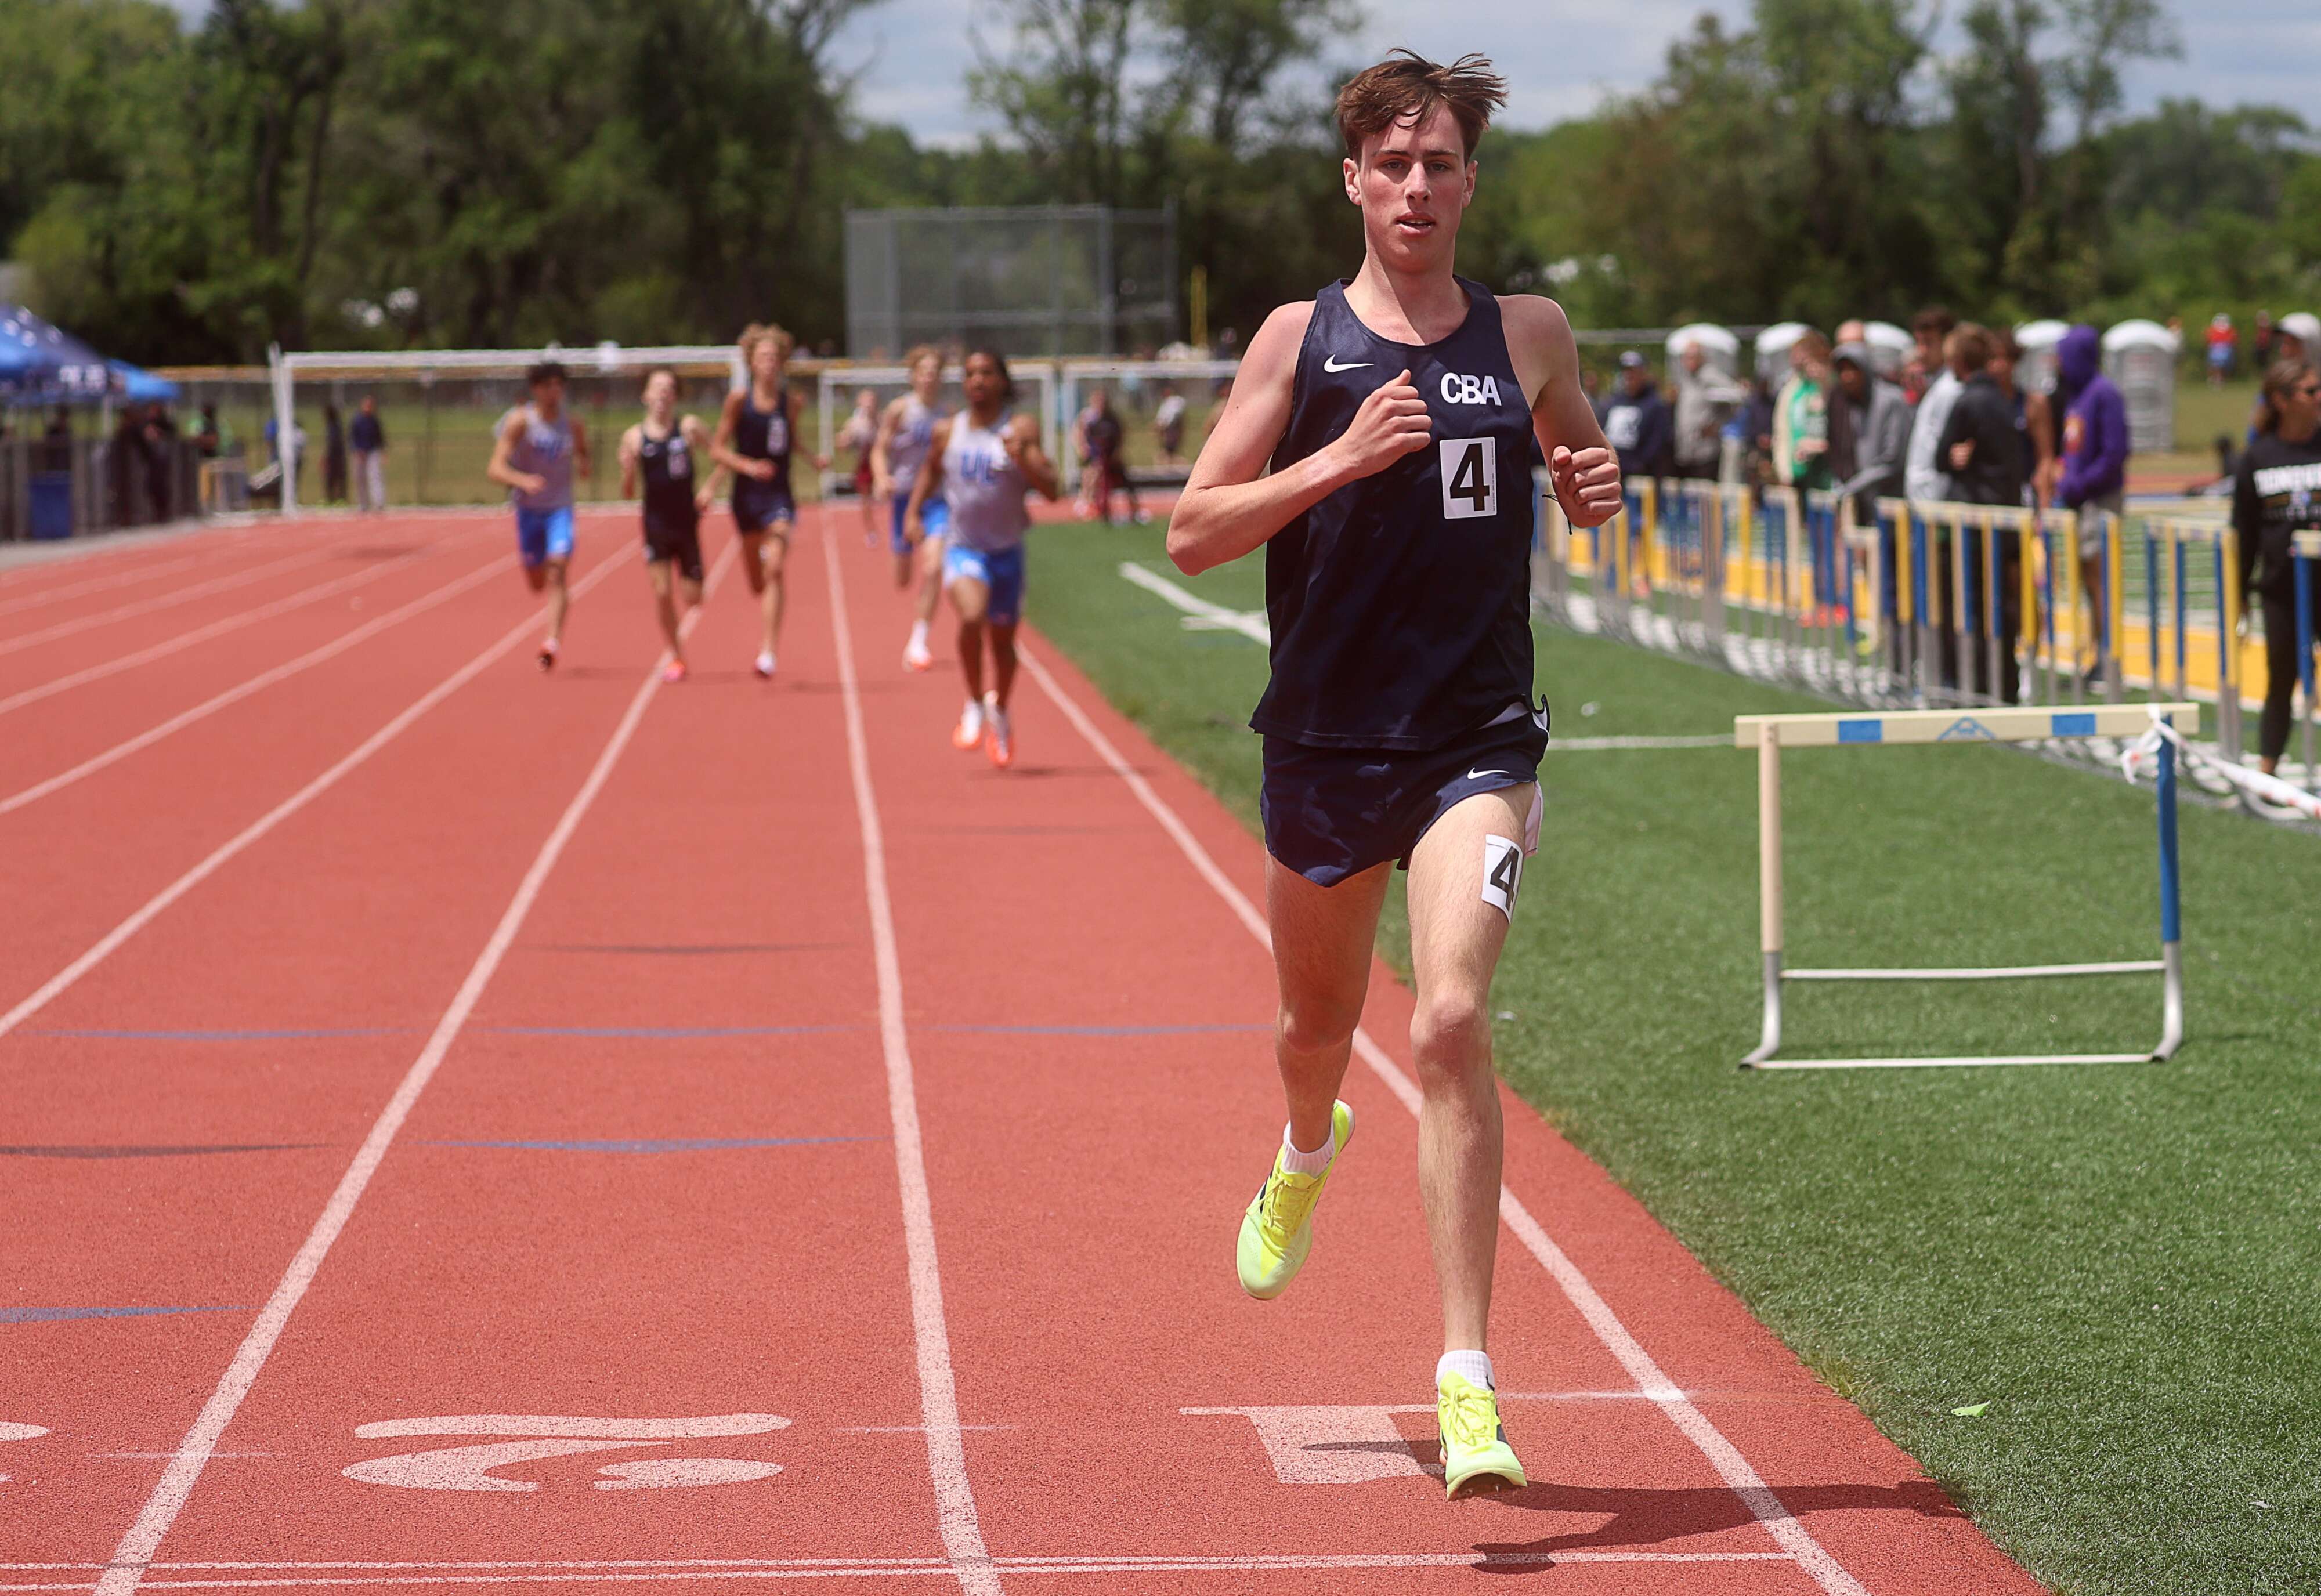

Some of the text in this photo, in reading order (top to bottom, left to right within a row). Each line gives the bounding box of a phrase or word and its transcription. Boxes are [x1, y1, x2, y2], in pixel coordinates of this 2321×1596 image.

[1440, 372, 1502, 406] CBA
[1449, 443, 1490, 512] 4
[1490, 845, 1520, 912] 4
[341, 1413, 794, 1492] 2
